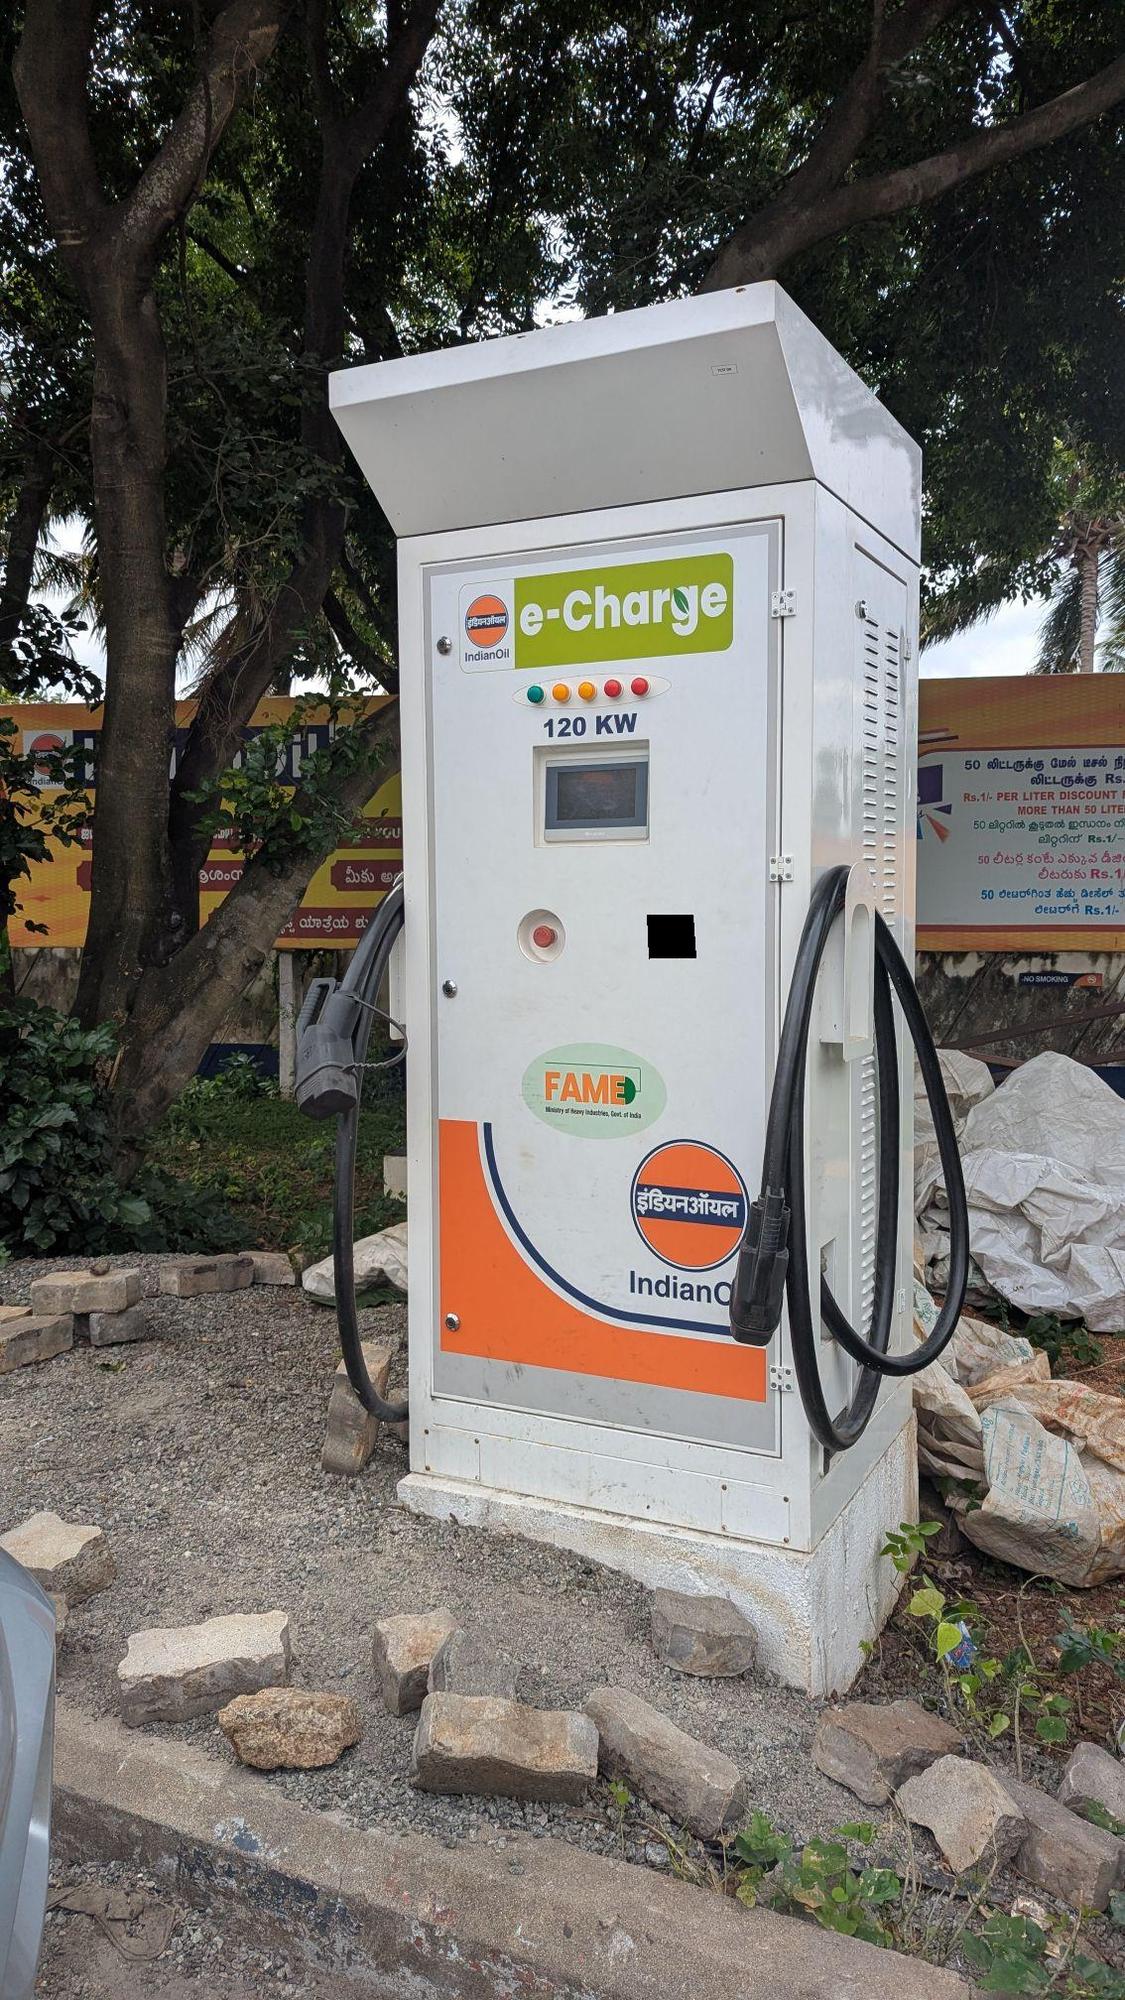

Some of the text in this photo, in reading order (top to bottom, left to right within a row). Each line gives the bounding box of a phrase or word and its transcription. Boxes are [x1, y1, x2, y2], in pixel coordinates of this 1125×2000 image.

[519, 582, 727, 636] e-Charge
[464, 648, 510, 663] IndianOil
[543, 712, 638, 739] 120 KW
[964, 759, 981, 770] 50
[987, 757, 1044, 772] லிட்டருக்கு
[1030, 772, 1097, 788] லிட்டருக்கு
[996, 791, 1018, 801] PER
[1023, 790, 1055, 801] LITER
[1059, 789, 1118, 800] DISCOUNT
[1017, 805, 1047, 816] MORE
[1051, 805, 1080, 815] THAN
[1084, 804, 1097, 814] 50
[973, 820, 986, 830] 50
[978, 855, 990, 864] 50
[981, 889, 995, 900] 50
[1085, 904, 1120, 915] Rs.1/-
[1035, 975, 1069, 984] SMOKING
[545, 1071, 625, 1106] FAME
[545, 1106, 564, 1115] Ministry
[571, 1108, 585, 1117] Heavy
[630, 1112, 642, 1120] India
[636, 1190, 739, 1218] इंडियनऑयल
[629, 1270, 734, 1307] IndianO
